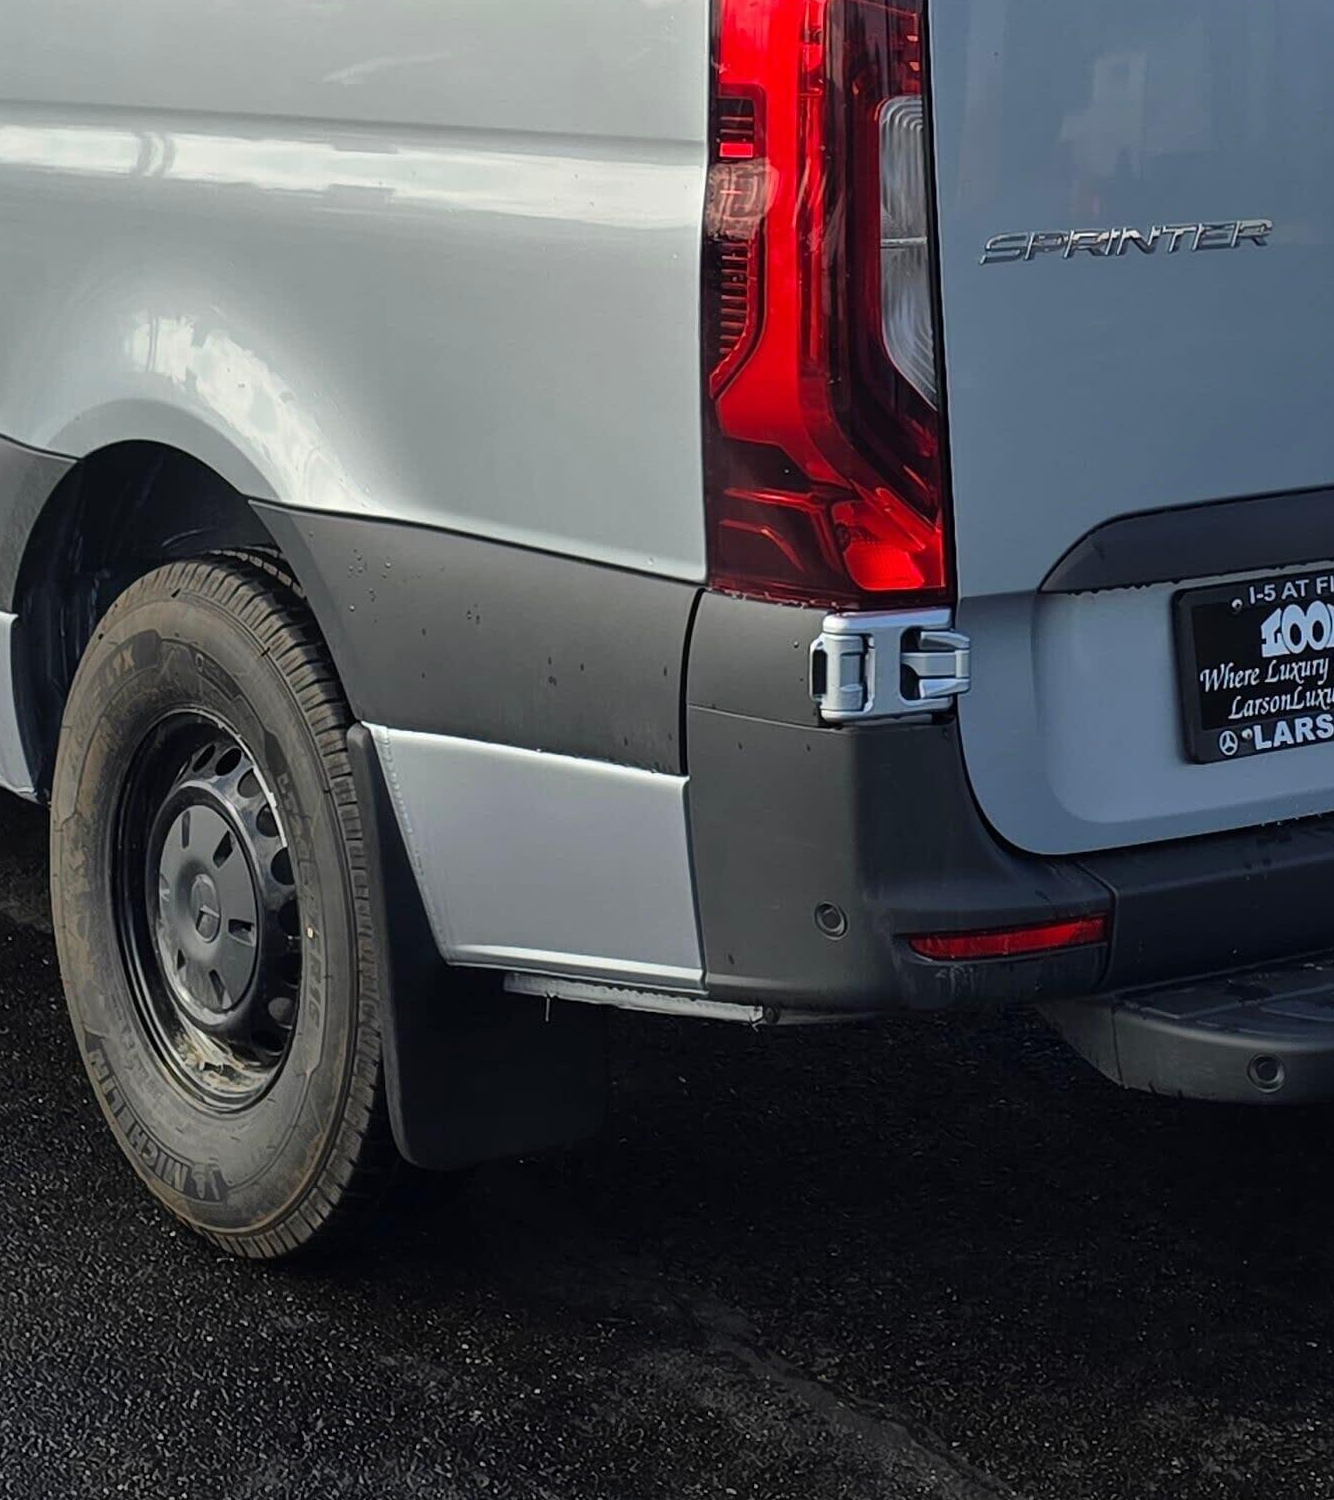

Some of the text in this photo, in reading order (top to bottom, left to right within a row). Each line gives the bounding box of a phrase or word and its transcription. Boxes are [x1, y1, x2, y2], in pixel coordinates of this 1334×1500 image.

[979, 218, 1273, 265] SPRINTER
[1249, 584, 1276, 605] I-5
[1281, 579, 1310, 600] AT
[1200, 663, 1260, 692] Where
[1264, 658, 1329, 685] Luxury
[86, 1048, 189, 1192] MICHELIN
